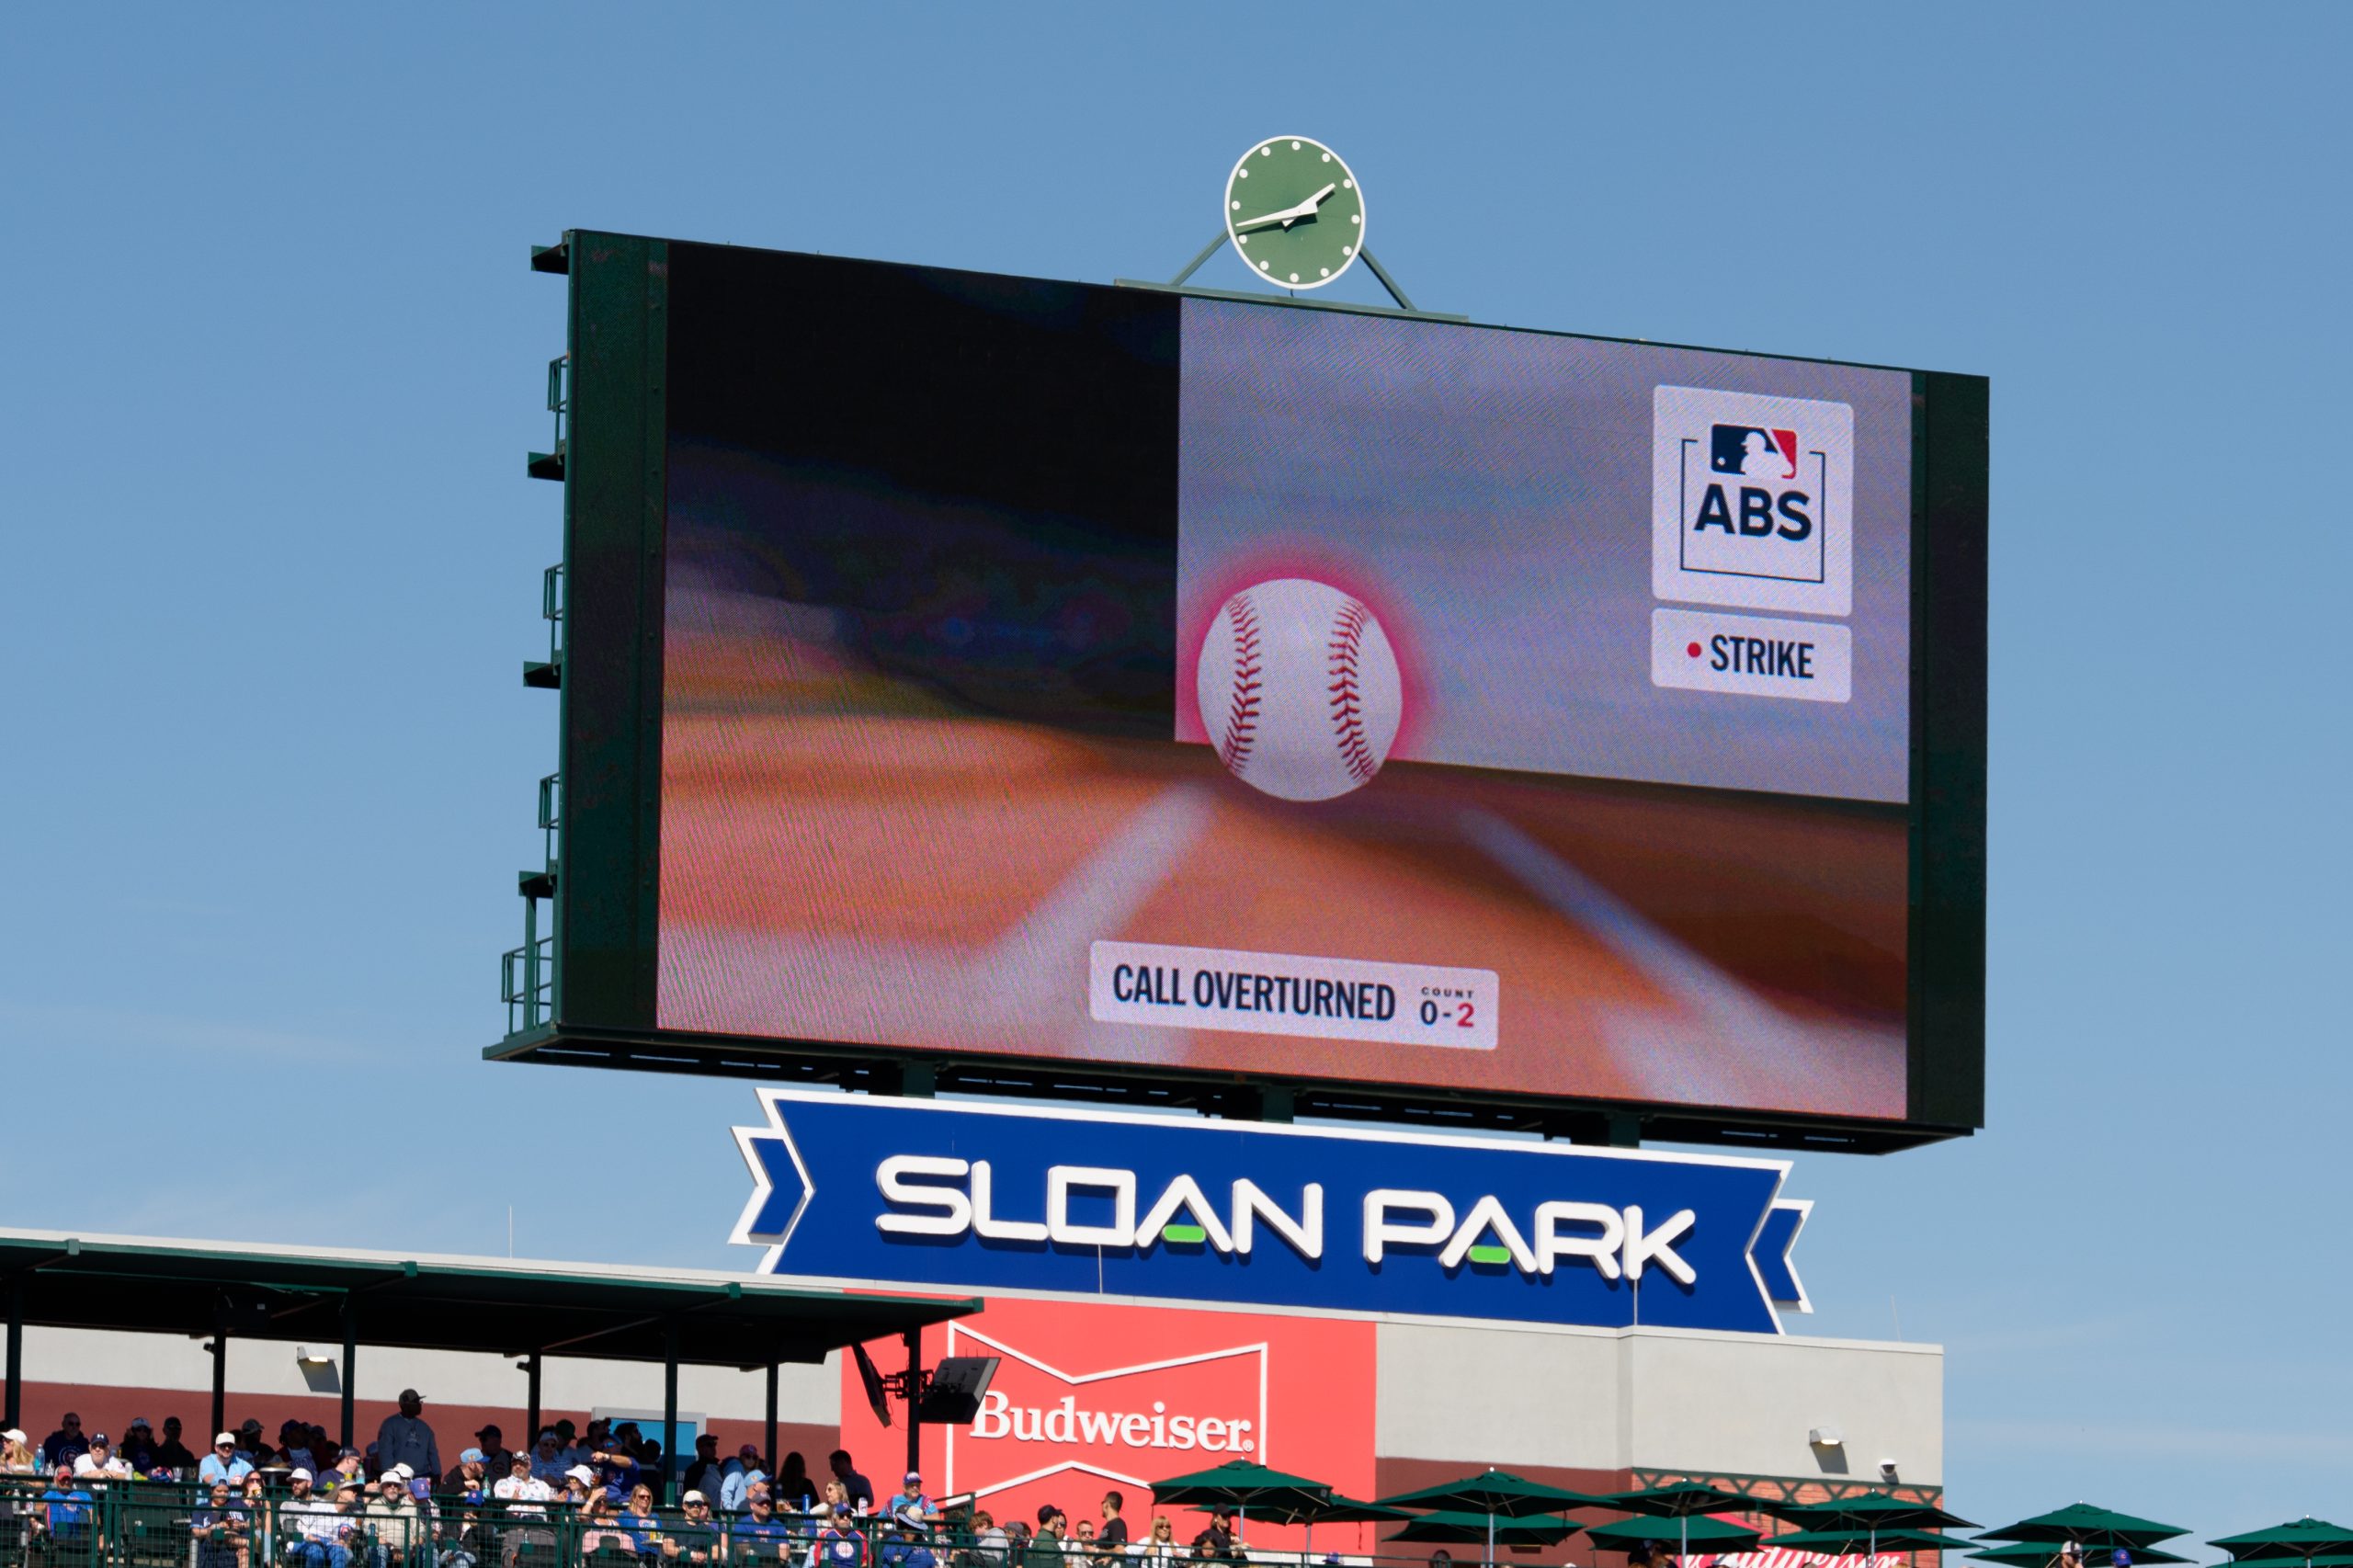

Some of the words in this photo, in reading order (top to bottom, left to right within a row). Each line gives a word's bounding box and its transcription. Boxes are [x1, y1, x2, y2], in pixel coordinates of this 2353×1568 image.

[1694, 483, 1812, 541] ABS
[1710, 634, 1814, 679] STRIKE
[1113, 963, 1187, 1006] CALL
[1194, 970, 1396, 1022] OVERTURNED
[1421, 986, 1474, 999] COUNT
[875, 1154, 1324, 1259] SLOAN
[1363, 1188, 1697, 1285] PARK
